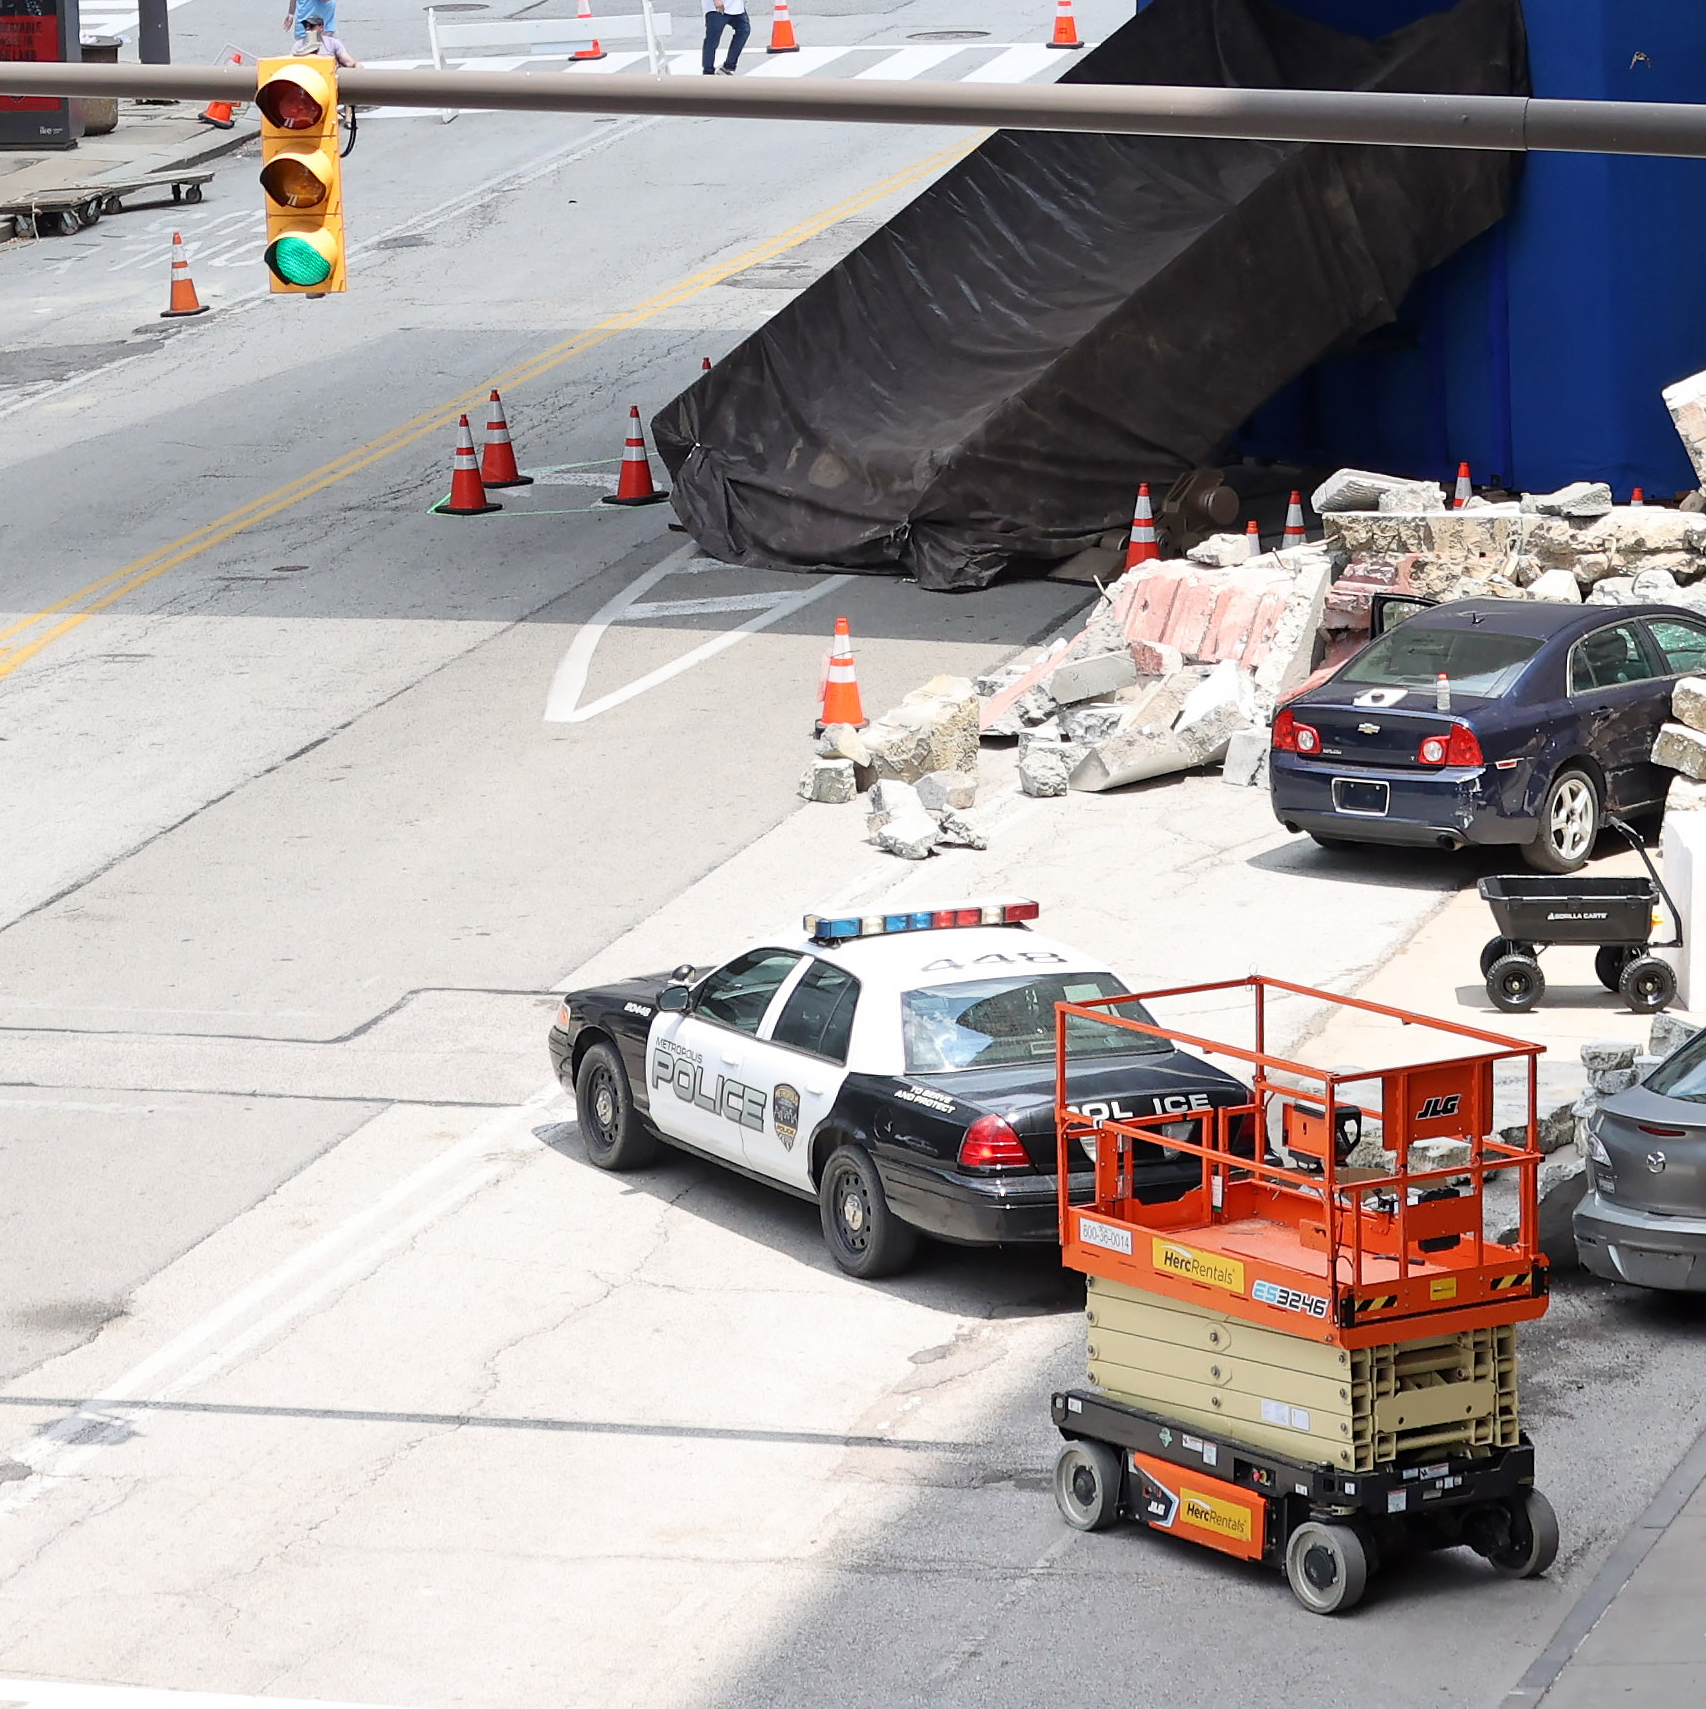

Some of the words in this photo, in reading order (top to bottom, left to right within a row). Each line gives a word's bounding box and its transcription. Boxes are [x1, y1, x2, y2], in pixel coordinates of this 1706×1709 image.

[1554, 912, 1582, 920] GORILLA
[920, 951, 1068, 972] 448
[655, 1036, 703, 1064] METROPOLIS
[651, 1047, 767, 1133] POLICE
[893, 1089, 916, 1103] AND
[914, 1094, 956, 1114] PROTECT
[909, 1085, 922, 1094] TO
[921, 1088, 953, 1104] SERVE
[1415, 1093, 1462, 1121] JLG
[1163, 1251, 1235, 1286] HercRentals
[1253, 1280, 1328, 1317] ES3246
[1147, 1500, 1166, 1516] JLG
[1185, 1503, 1246, 1533] HercRentals
